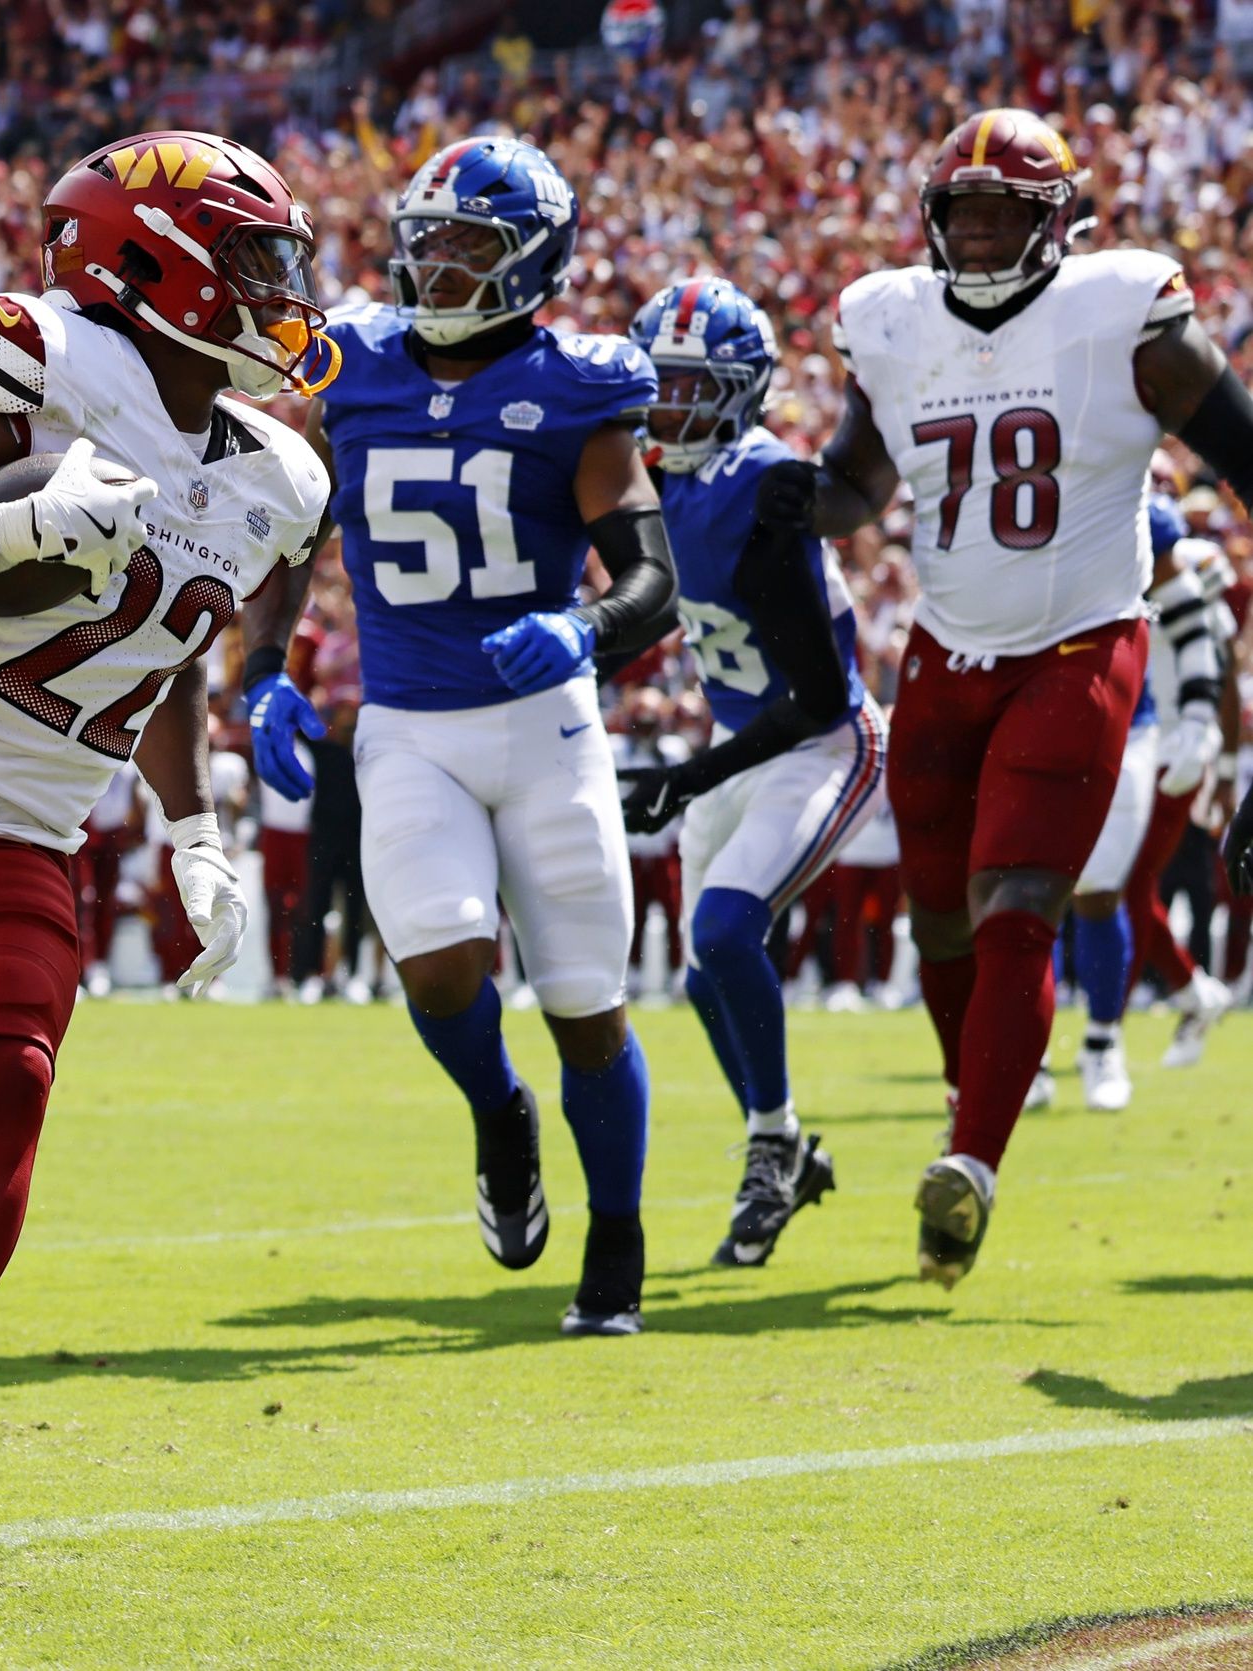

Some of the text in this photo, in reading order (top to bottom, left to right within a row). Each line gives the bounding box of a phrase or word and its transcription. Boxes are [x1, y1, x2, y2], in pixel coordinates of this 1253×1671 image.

[920, 388, 1055, 411] WASHINGTON
[364, 448, 537, 606] 51
[911, 406, 1061, 552] 78
[146, 523, 240, 578] SHINGTON
